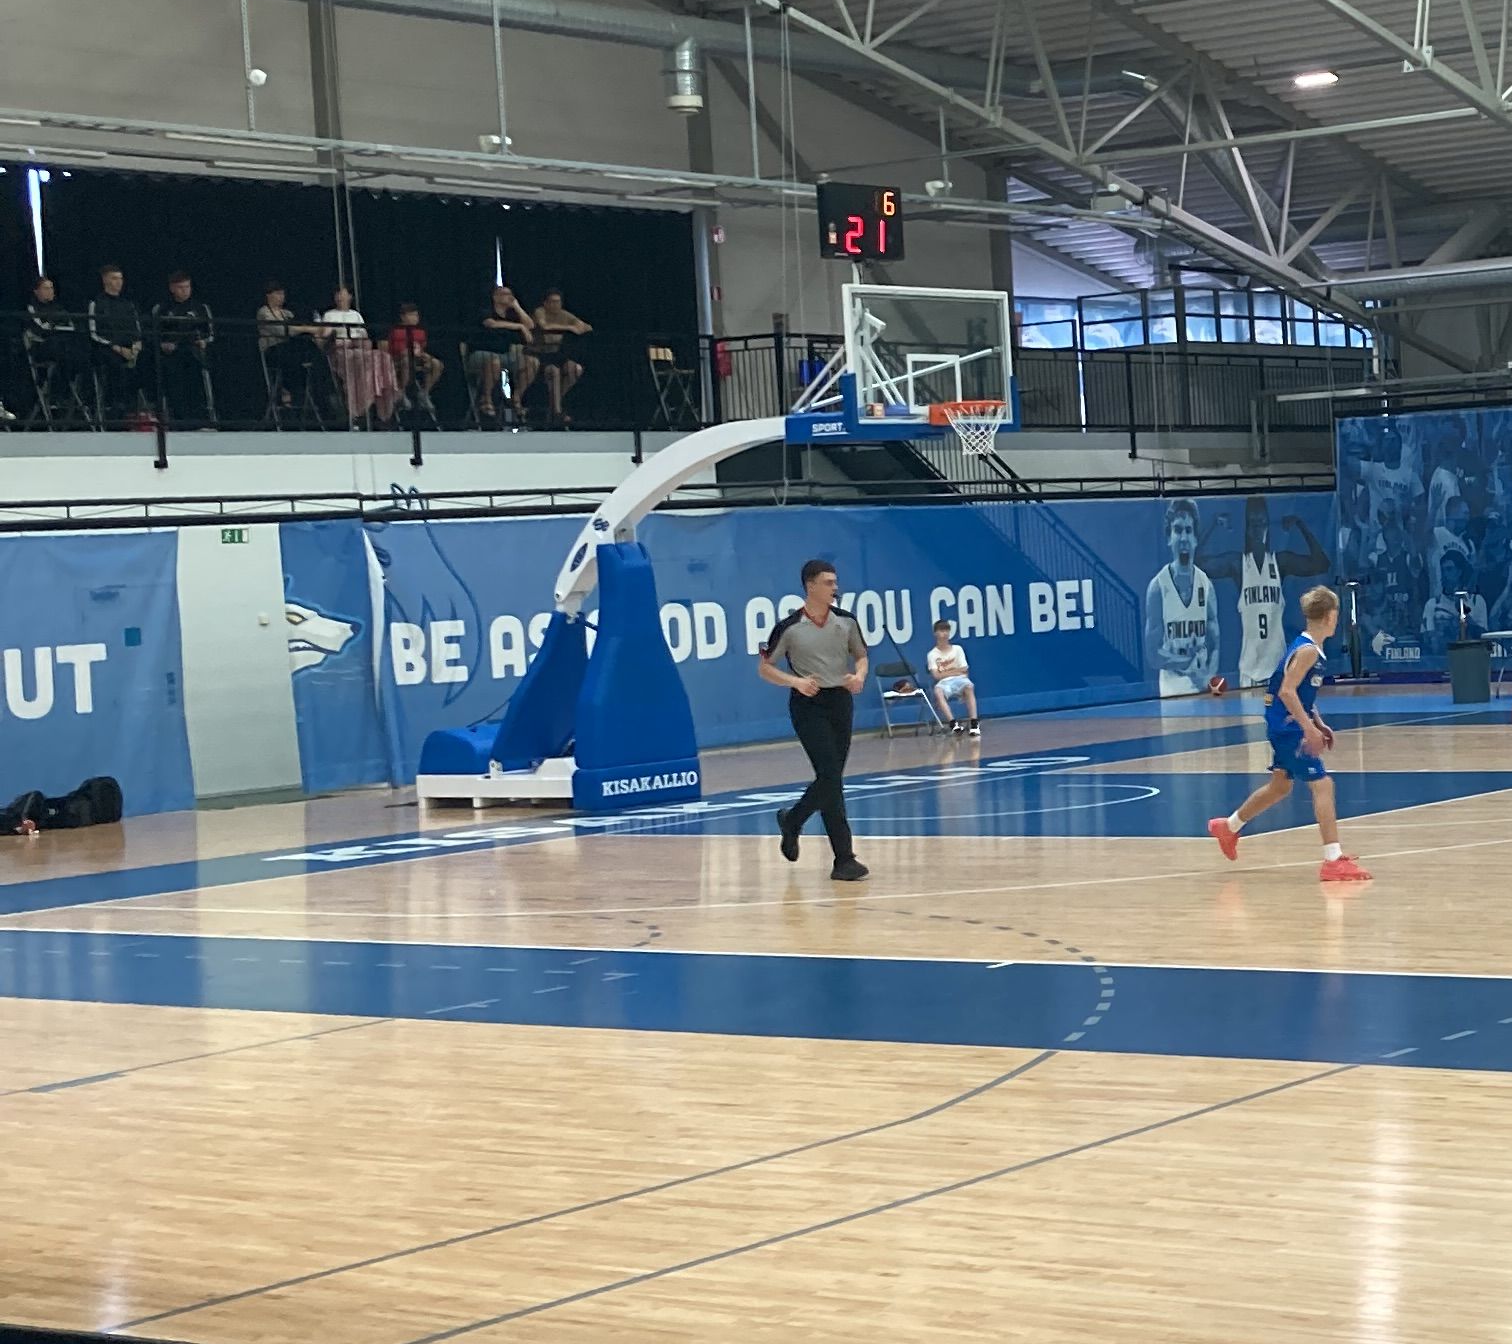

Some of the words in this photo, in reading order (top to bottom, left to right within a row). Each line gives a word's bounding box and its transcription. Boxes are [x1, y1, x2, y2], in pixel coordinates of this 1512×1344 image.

[883, 191, 896, 216] 6
[845, 216, 886, 253] 21
[391, 620, 469, 685] BE
[930, 584, 1015, 640] CAN
[1029, 578, 1095, 634] BE!
[1258, 613, 1268, 639] 9
[602, 771, 698, 796] KISAKALLIO
